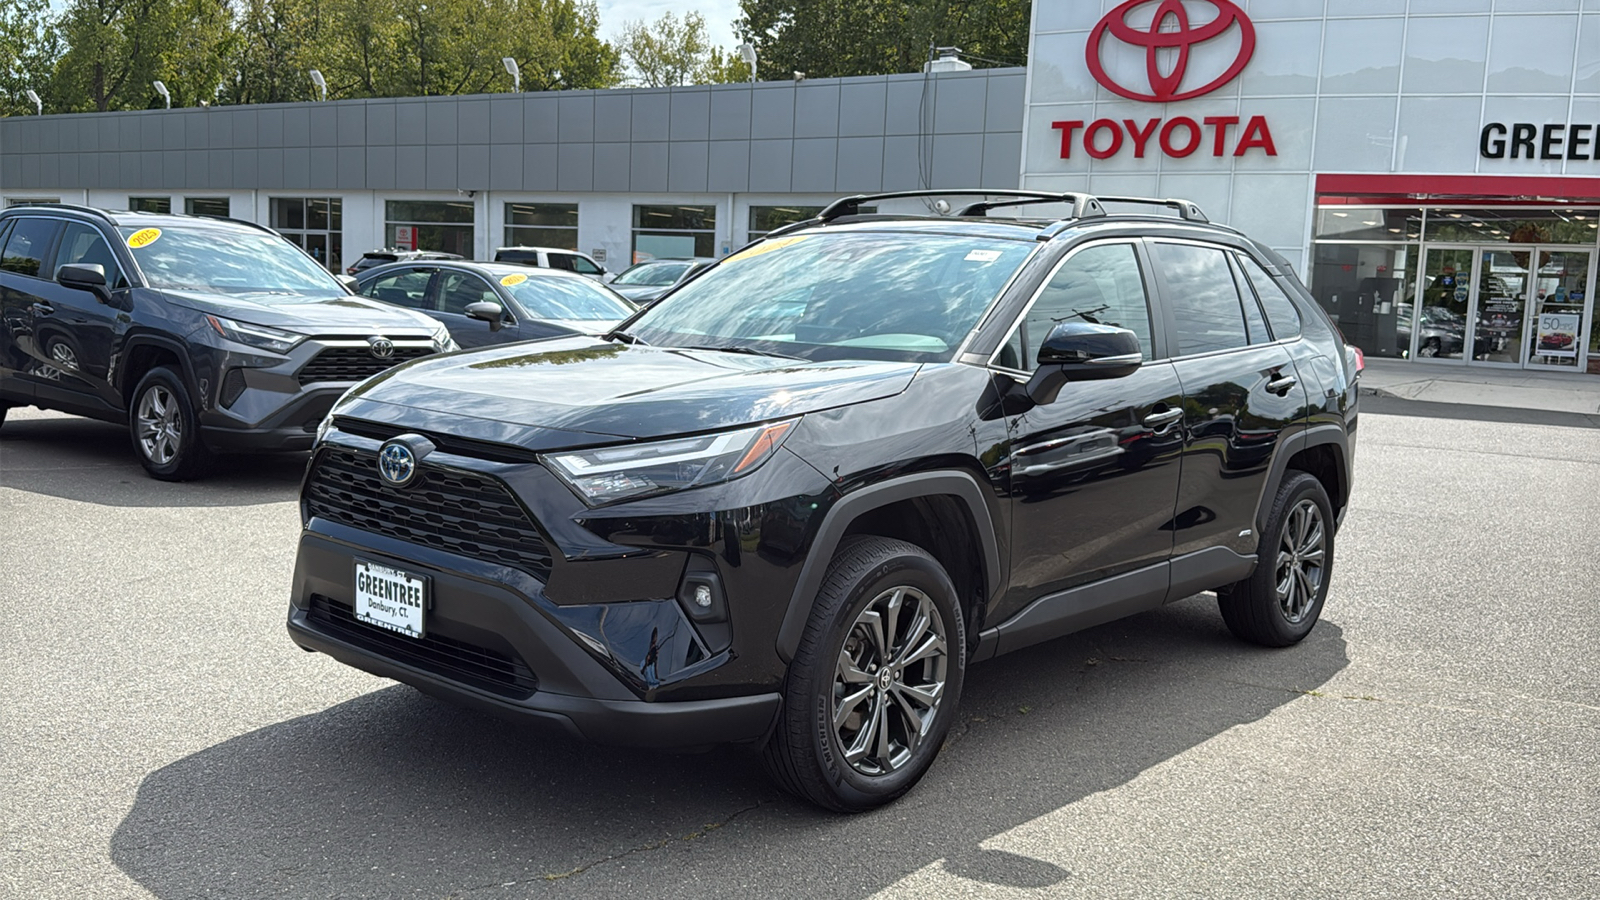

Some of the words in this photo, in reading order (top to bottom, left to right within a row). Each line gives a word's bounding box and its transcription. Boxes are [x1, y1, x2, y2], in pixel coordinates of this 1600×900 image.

[1052, 115, 1278, 159] TOYOTA
[133, 230, 157, 246] 2025
[1542, 317, 1560, 331] 50
[358, 572, 421, 608] GREENTREE
[368, 597, 397, 617] Danbury,
[357, 614, 419, 638] GREENTREE
[954, 608, 965, 667] MICHELIN
[818, 697, 832, 763] MICHELIN
